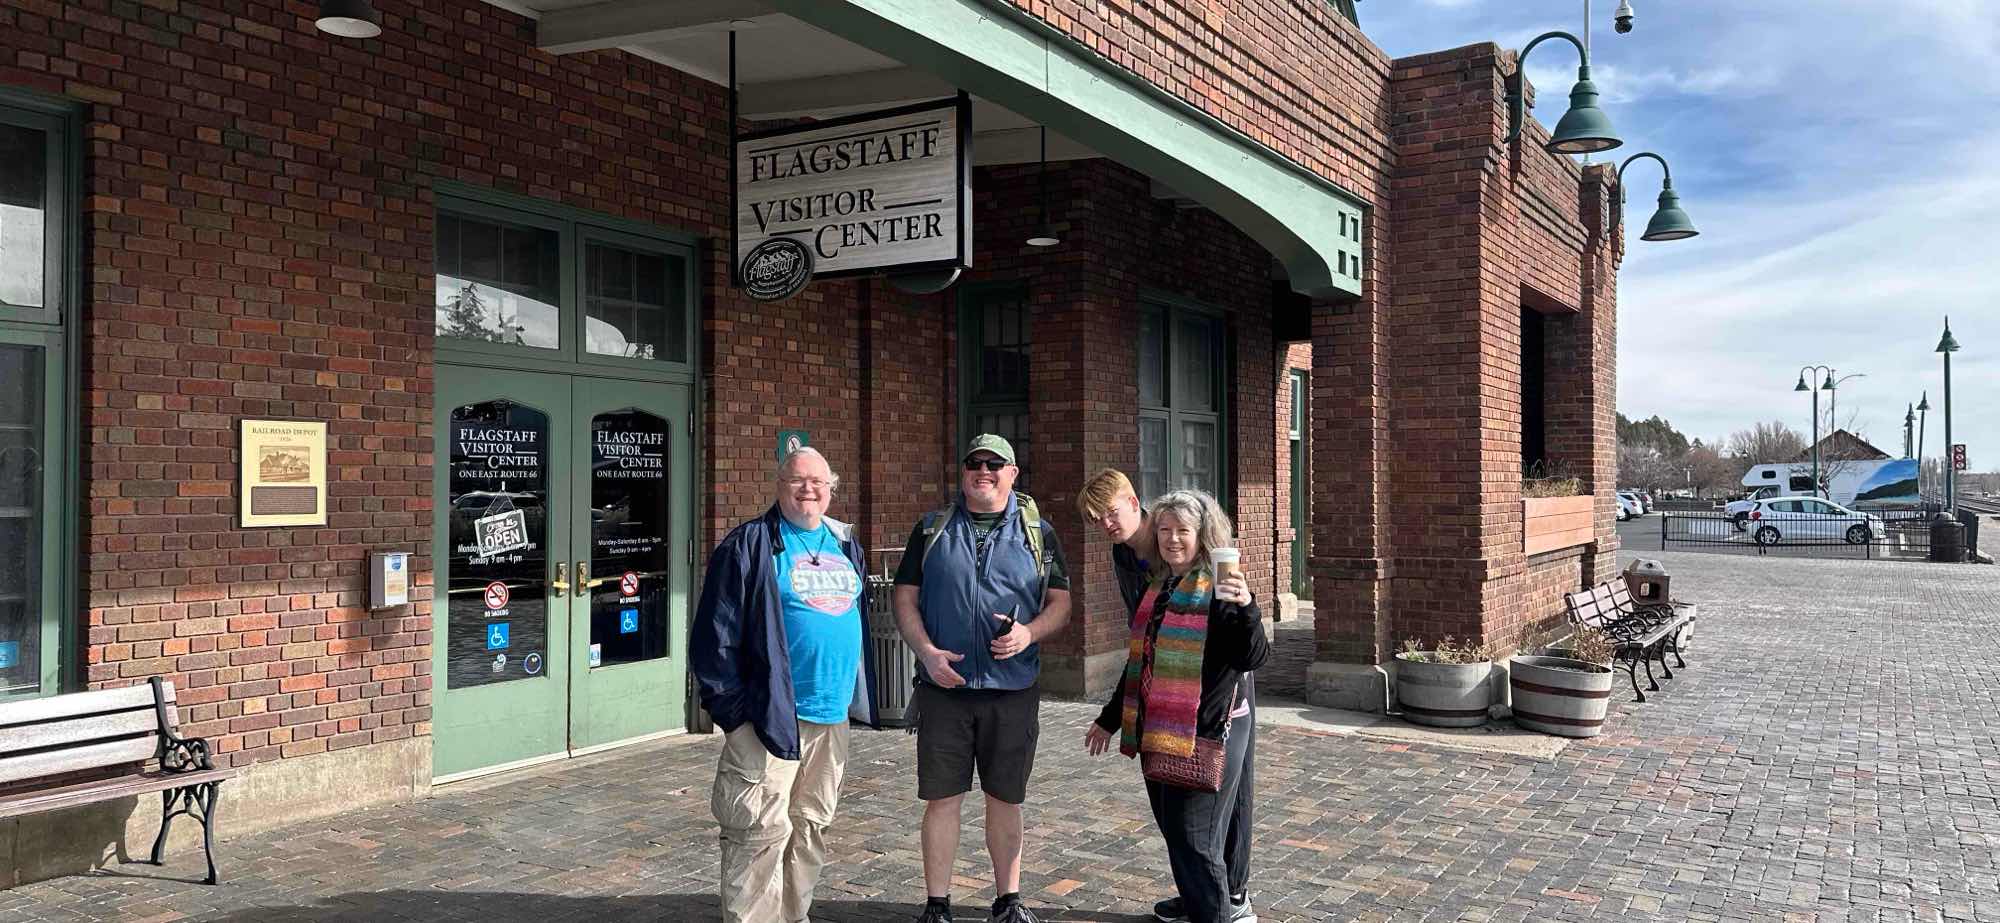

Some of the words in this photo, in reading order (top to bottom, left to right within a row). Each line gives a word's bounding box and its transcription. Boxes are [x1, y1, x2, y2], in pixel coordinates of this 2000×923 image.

[750, 127, 940, 182] FLAGSTAFF
[749, 187, 877, 235] VISITOR
[814, 212, 944, 259] CENTER
[252, 427, 292, 435] RAILROAD
[459, 428, 537, 442] FLAGSTAFF
[597, 430, 664, 445] FLAGSTAFF
[459, 442, 513, 456] VISITOR
[597, 444, 642, 456] VISITOR
[488, 455, 538, 469] CENTER
[620, 457, 663, 469] CENTER
[459, 470, 478, 478] ONE
[478, 470, 498, 478] EAST
[500, 470, 528, 478] ROUTE
[528, 470, 538, 478] 66
[596, 470, 613, 478] ONE
[613, 470, 631, 478] EAST
[631, 470, 656, 478] ROUTE
[655, 470, 663, 478] 66
[484, 528, 521, 548] OPEN
[609, 547, 627, 555] Sunday
[468, 555, 490, 566] Sunday
[491, 554, 496, 564] 9
[508, 553, 513, 562] 4
[513, 555, 523, 564] pm
[791, 570, 857, 593] STATE
